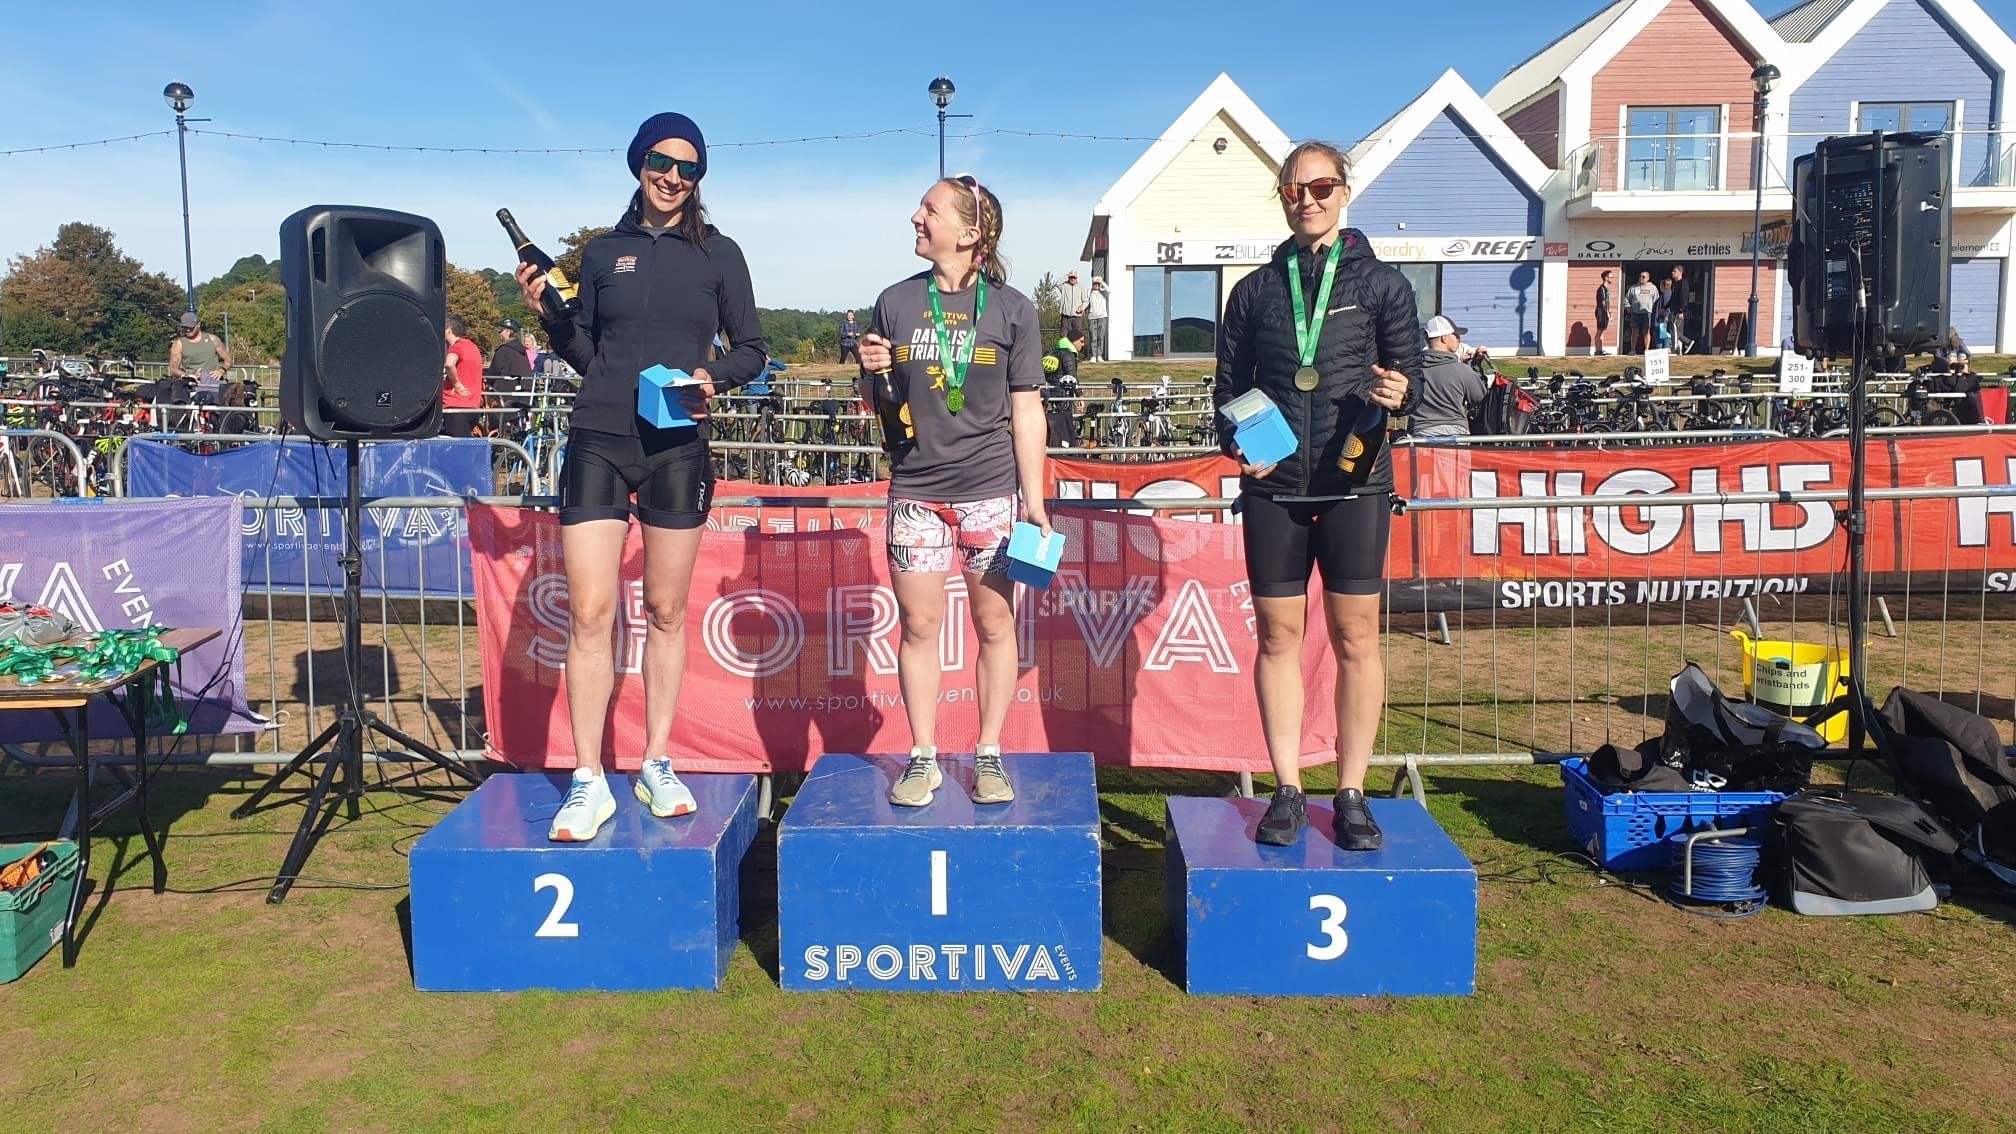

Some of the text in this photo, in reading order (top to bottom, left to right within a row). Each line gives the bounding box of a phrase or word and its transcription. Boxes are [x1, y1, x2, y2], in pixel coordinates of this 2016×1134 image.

[1471, 240, 1536, 260] REEF
[1577, 251, 1623, 259] OAKLEY
[1787, 362, 1809, 371] 251-
[1787, 375, 1806, 384] 300
[1470, 461, 1838, 555] HIGH5
[102, 558, 163, 629] EVEN
[1501, 577, 1809, 608] SPORTS NUTRITION
[1756, 663, 1807, 678] Chips and
[931, 849, 948, 916] 1
[534, 872, 579, 937] 2
[1307, 893, 1348, 961] 3
[804, 943, 1078, 982] SPORTIVA EVENTS
